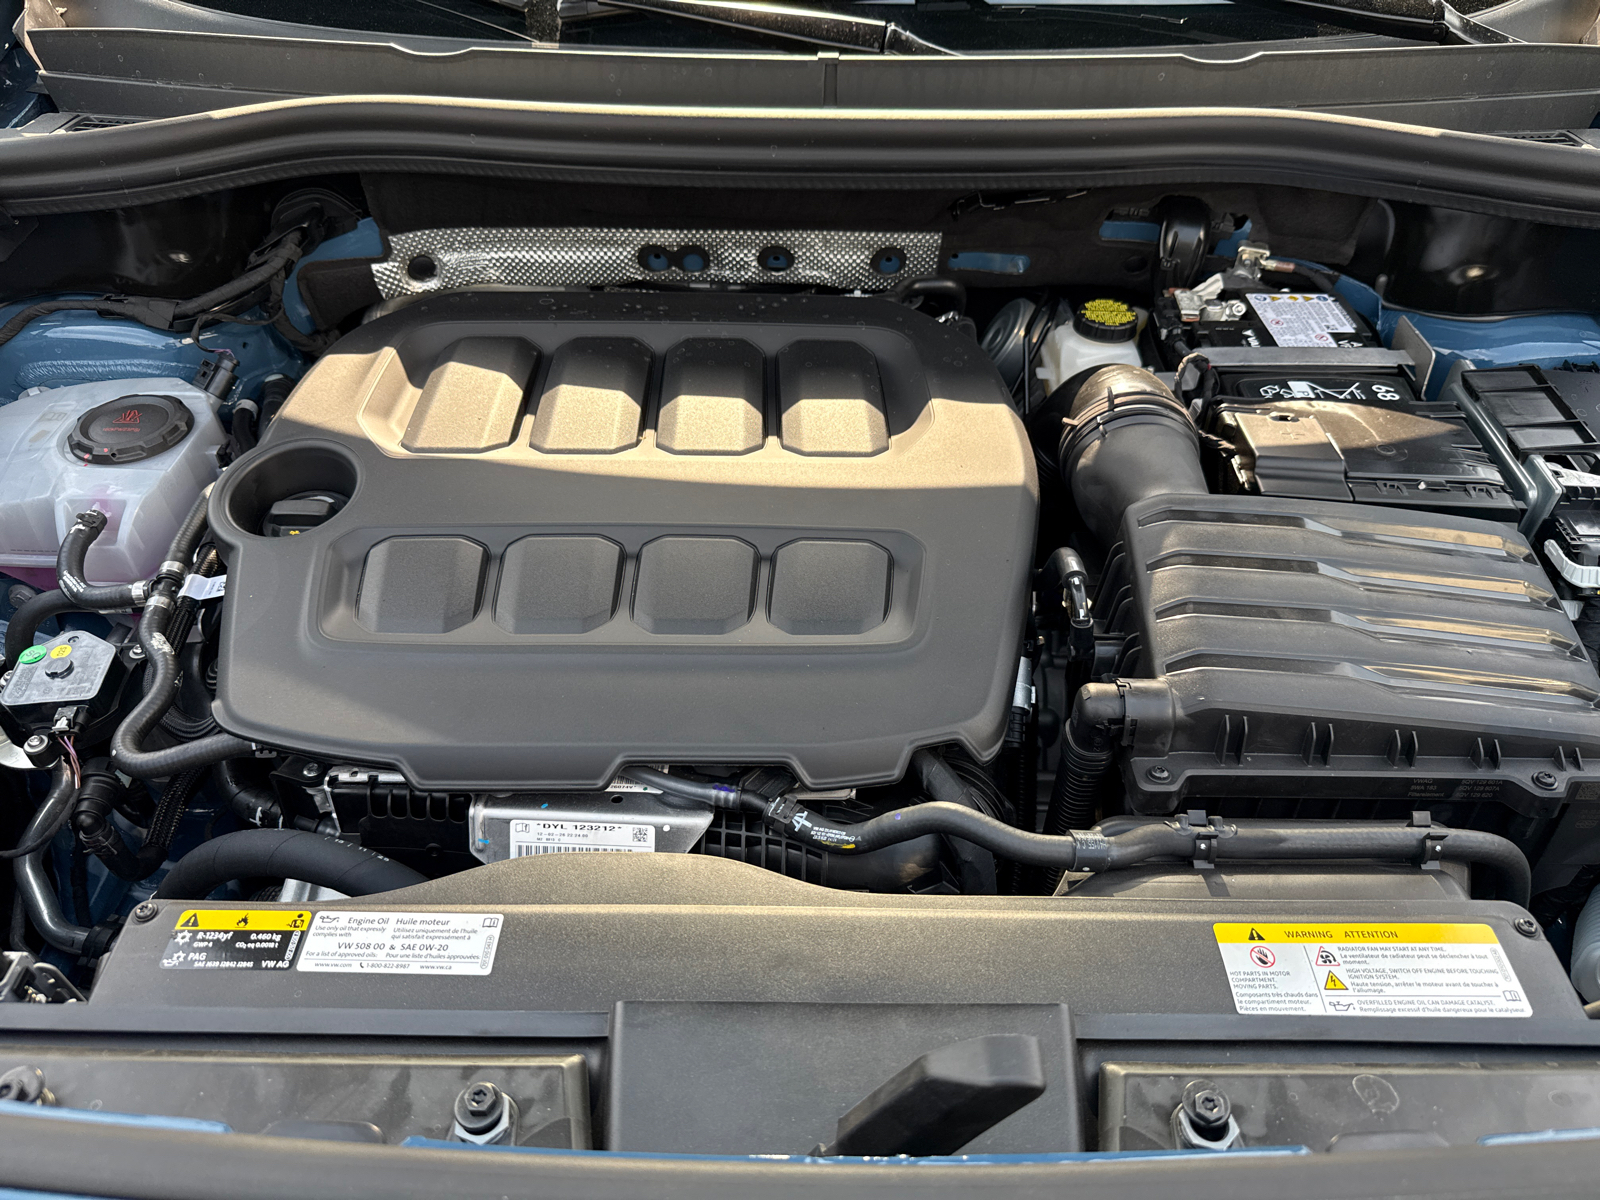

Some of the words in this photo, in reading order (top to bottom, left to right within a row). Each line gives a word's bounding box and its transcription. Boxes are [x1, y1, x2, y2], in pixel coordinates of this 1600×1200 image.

[348, 917, 376, 926] Engine
[196, 932, 234, 942] R-1234yf
[272, 933, 282, 942] kg
[1284, 930, 1333, 938] WARNING
[1344, 931, 1398, 939] ATTENTION
[337, 942, 354, 950] VW
[188, 952, 207, 960] PAG
